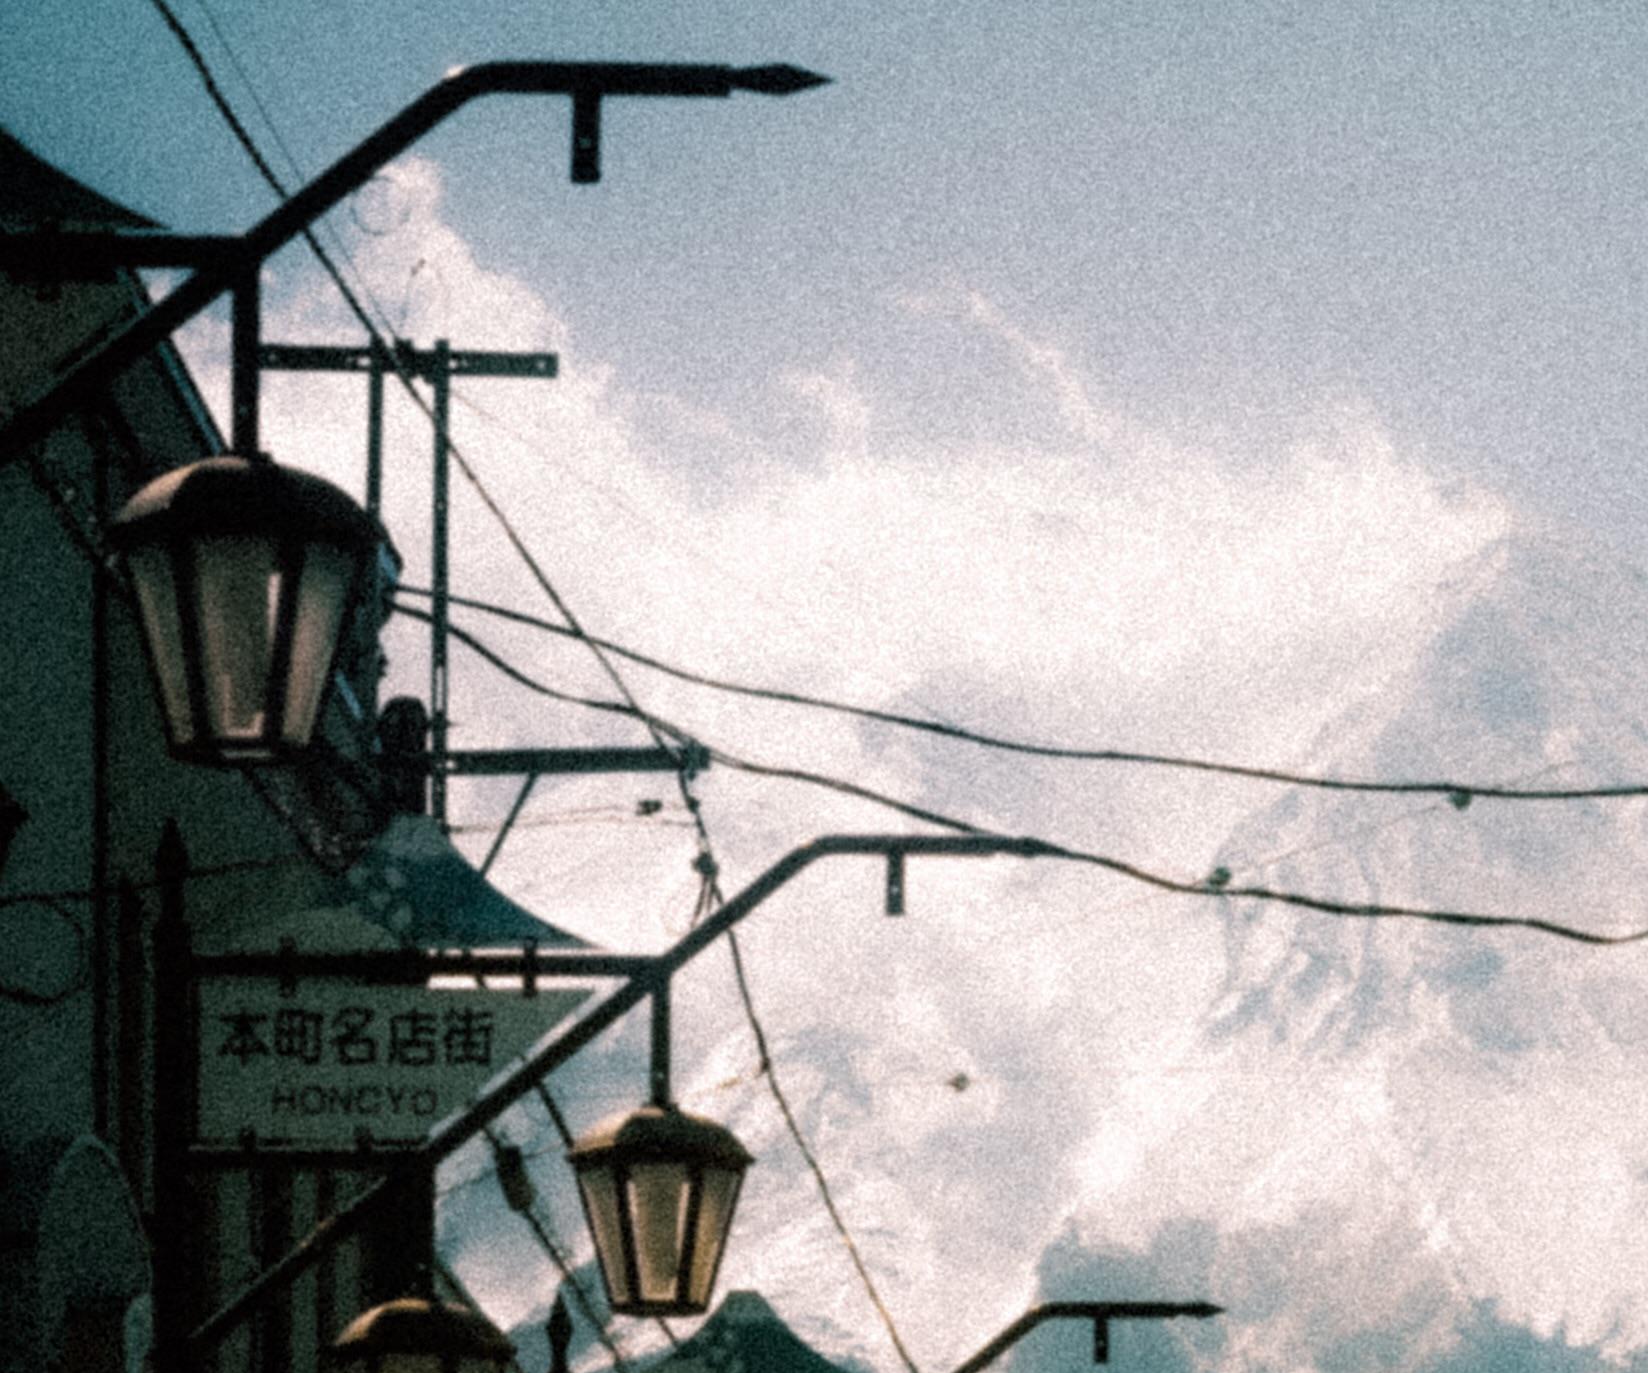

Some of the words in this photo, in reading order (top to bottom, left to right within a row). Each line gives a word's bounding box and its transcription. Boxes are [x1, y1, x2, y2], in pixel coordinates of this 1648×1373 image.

[217, 1006, 495, 1066] 本町名店街
